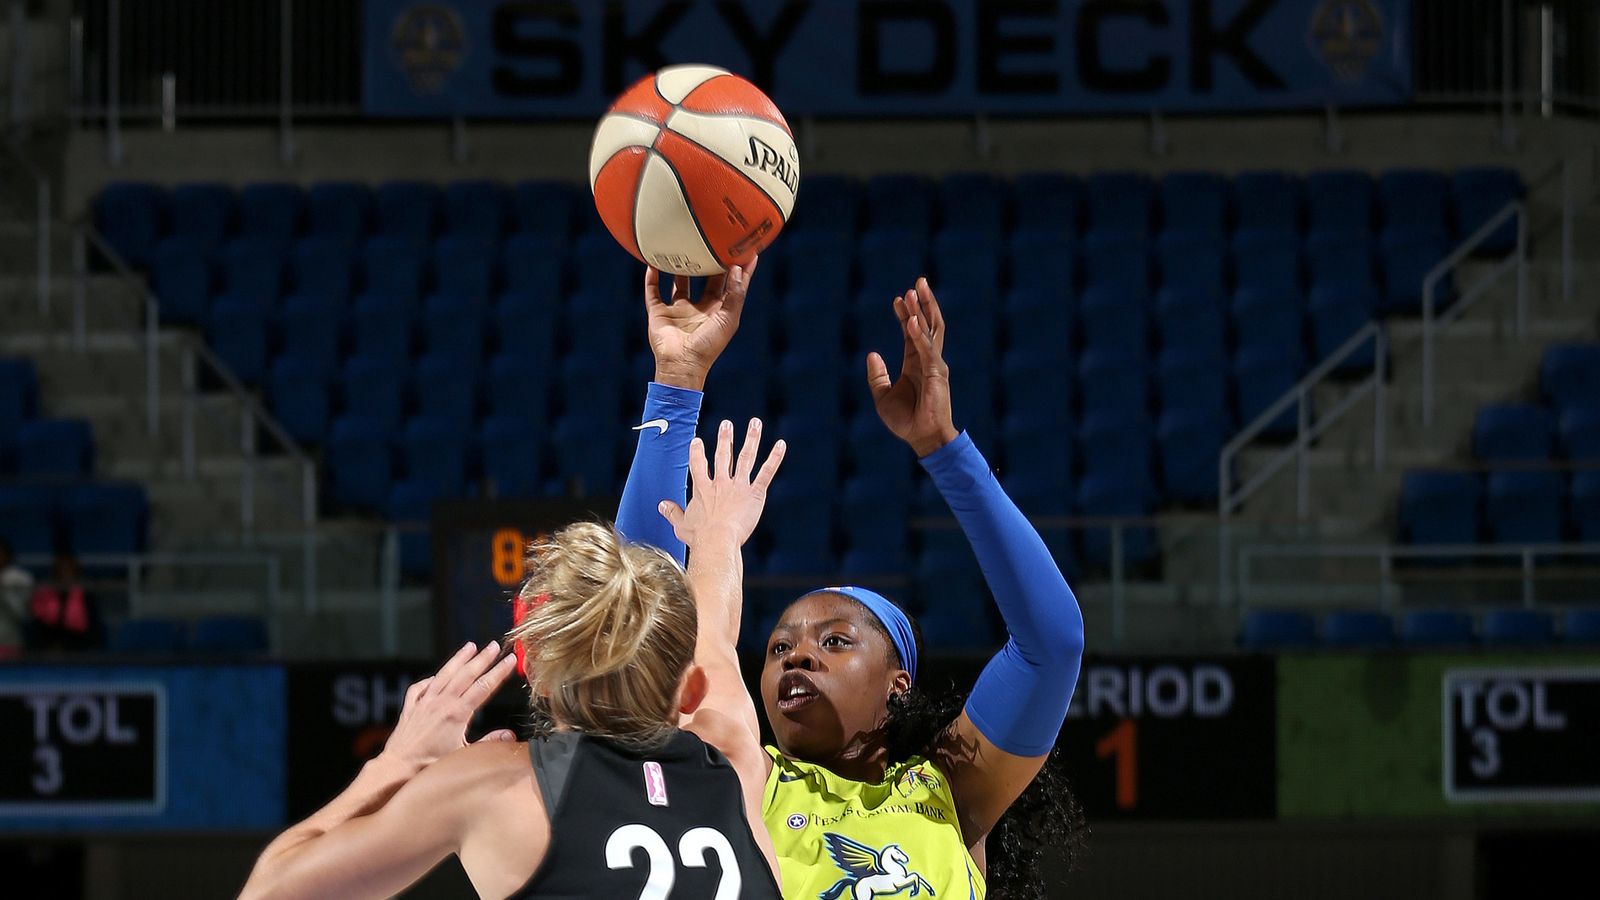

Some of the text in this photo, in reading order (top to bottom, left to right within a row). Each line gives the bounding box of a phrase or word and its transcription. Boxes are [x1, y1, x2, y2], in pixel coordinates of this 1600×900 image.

[491, 0, 1287, 97] SKY DECK
[27, 695, 138, 746] TOL
[1455, 681, 1568, 731] TOL
[29, 744, 63, 796] 3
[1095, 717, 1140, 812] 1
[1469, 725, 1501, 779] 3
[811, 802, 947, 827] TEXAS CAPITAL BANK
[605, 824, 742, 900] 22
